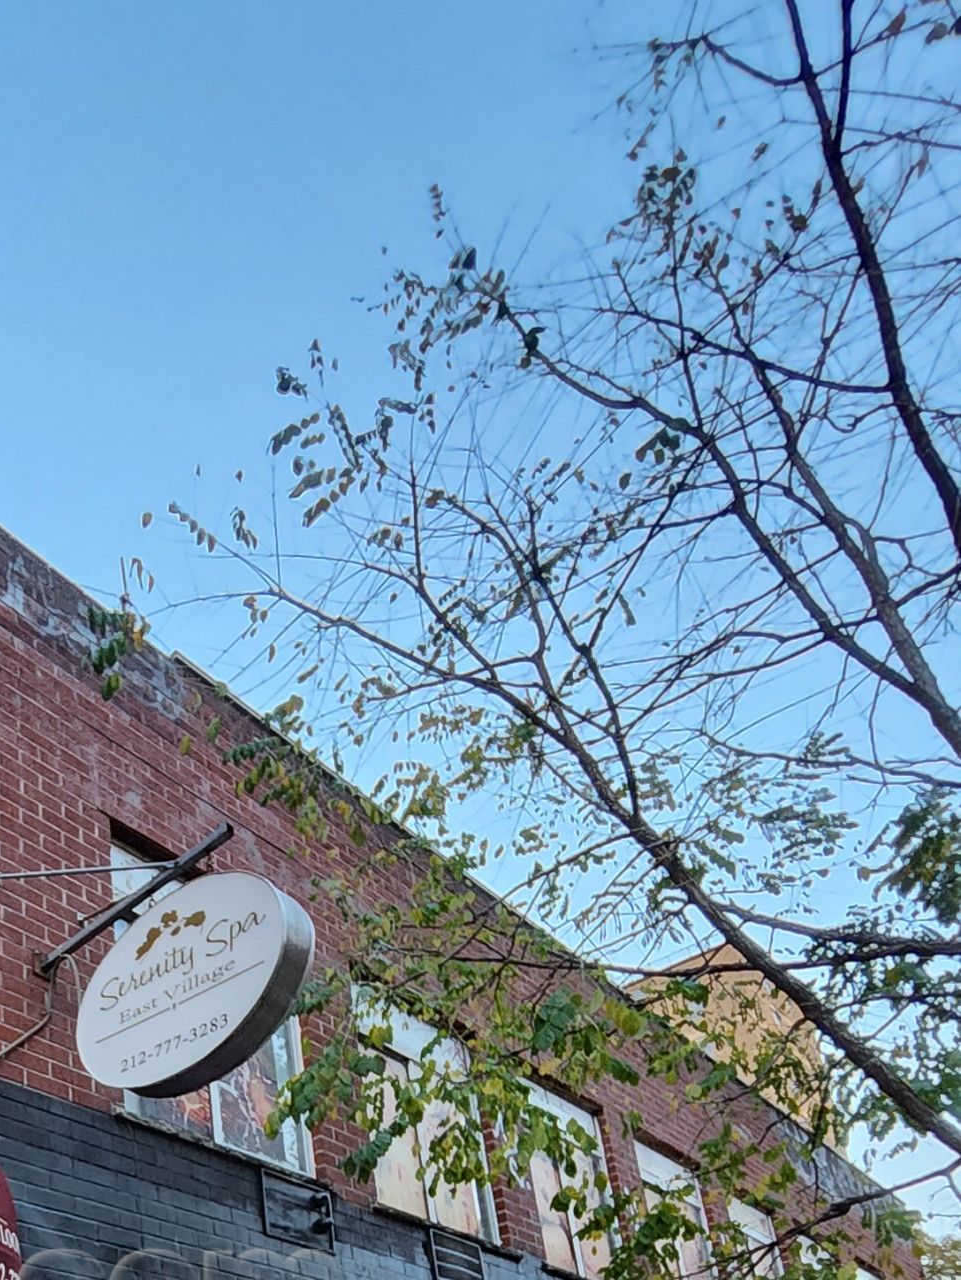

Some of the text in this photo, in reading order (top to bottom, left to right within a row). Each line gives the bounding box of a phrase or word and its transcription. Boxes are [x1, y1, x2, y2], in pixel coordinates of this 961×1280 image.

[100, 911, 267, 1011] Serenity Spa
[119, 959, 236, 1024] East Village
[120, 1013, 229, 1073] 212-777-3283
